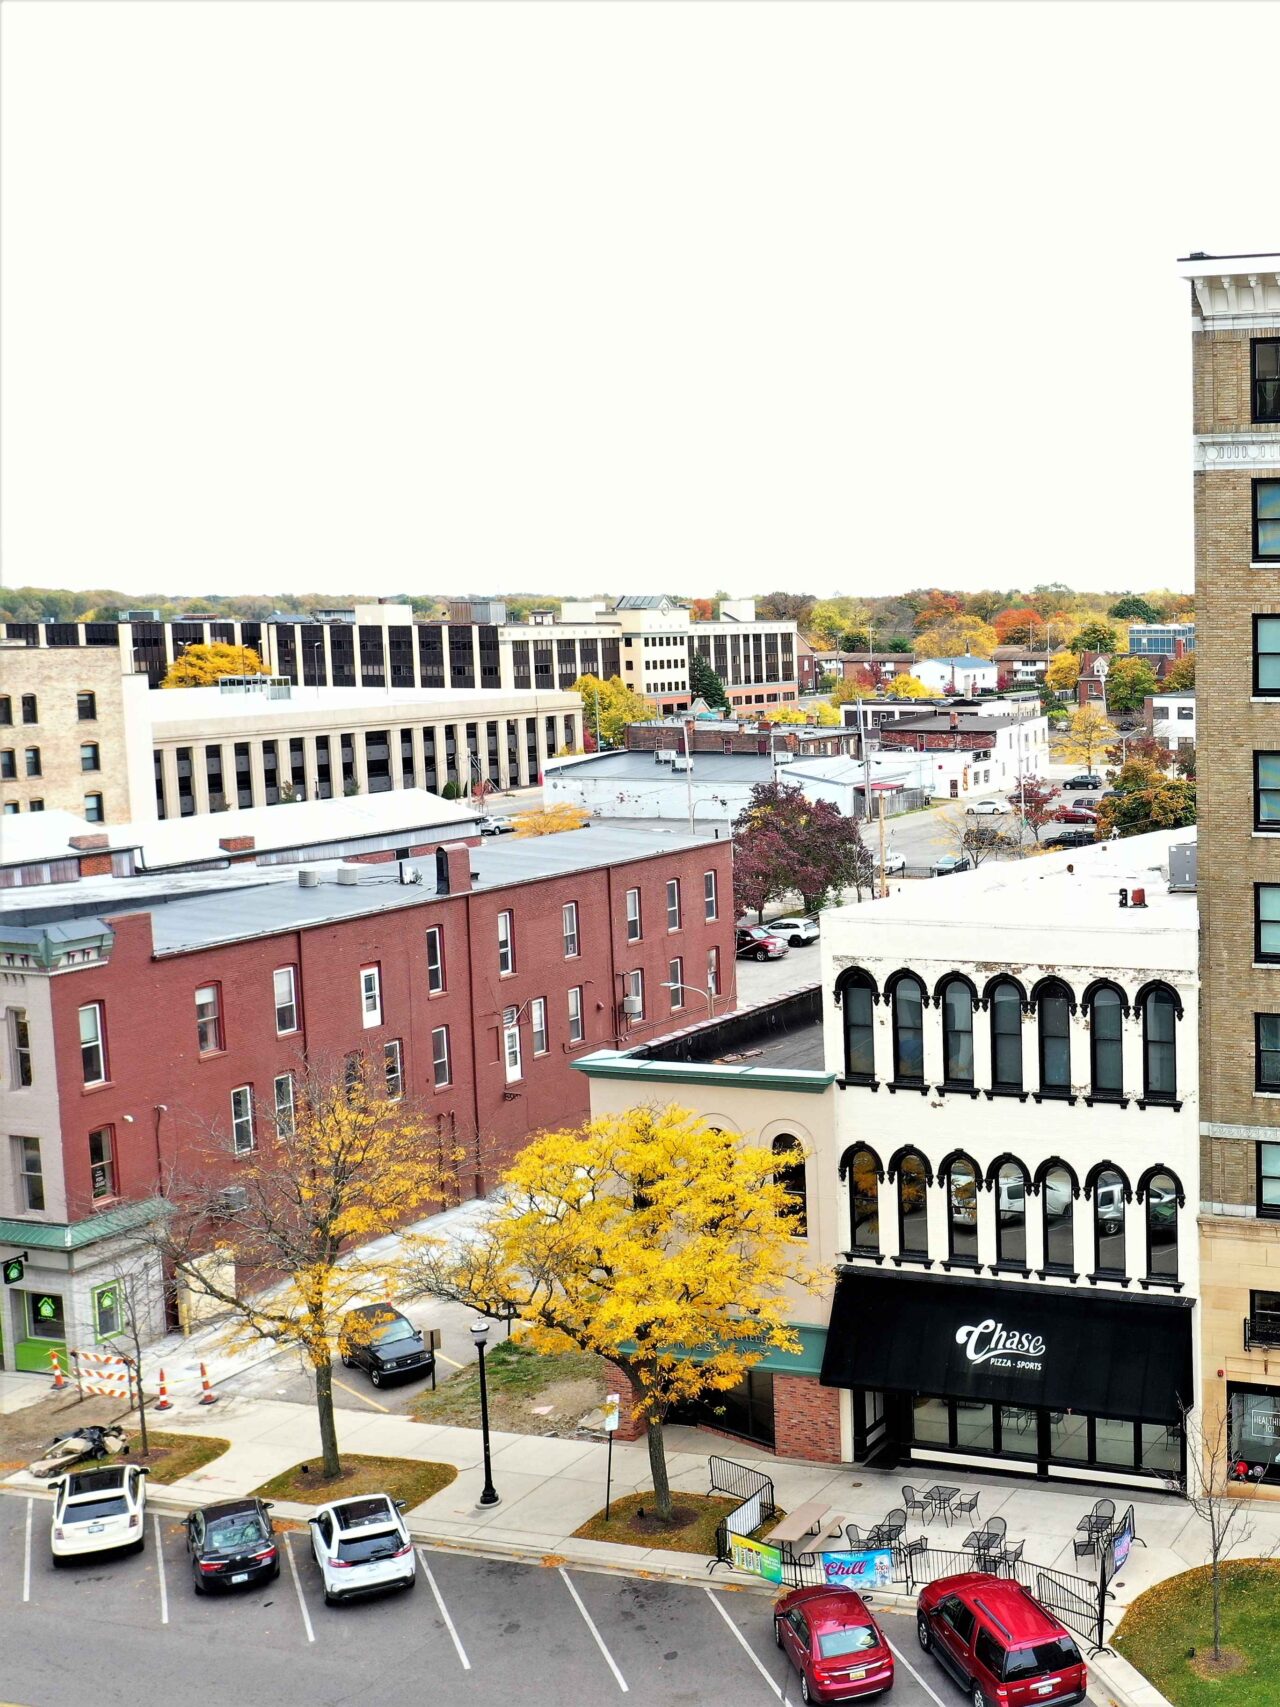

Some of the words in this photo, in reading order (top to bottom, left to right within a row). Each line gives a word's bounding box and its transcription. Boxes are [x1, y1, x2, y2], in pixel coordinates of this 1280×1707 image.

[955, 1319, 1046, 1365] Chase
[990, 1358, 1012, 1367] PIZZA
[1017, 1361, 1042, 1371] SPORTS
[825, 1561, 866, 1576] Chill
